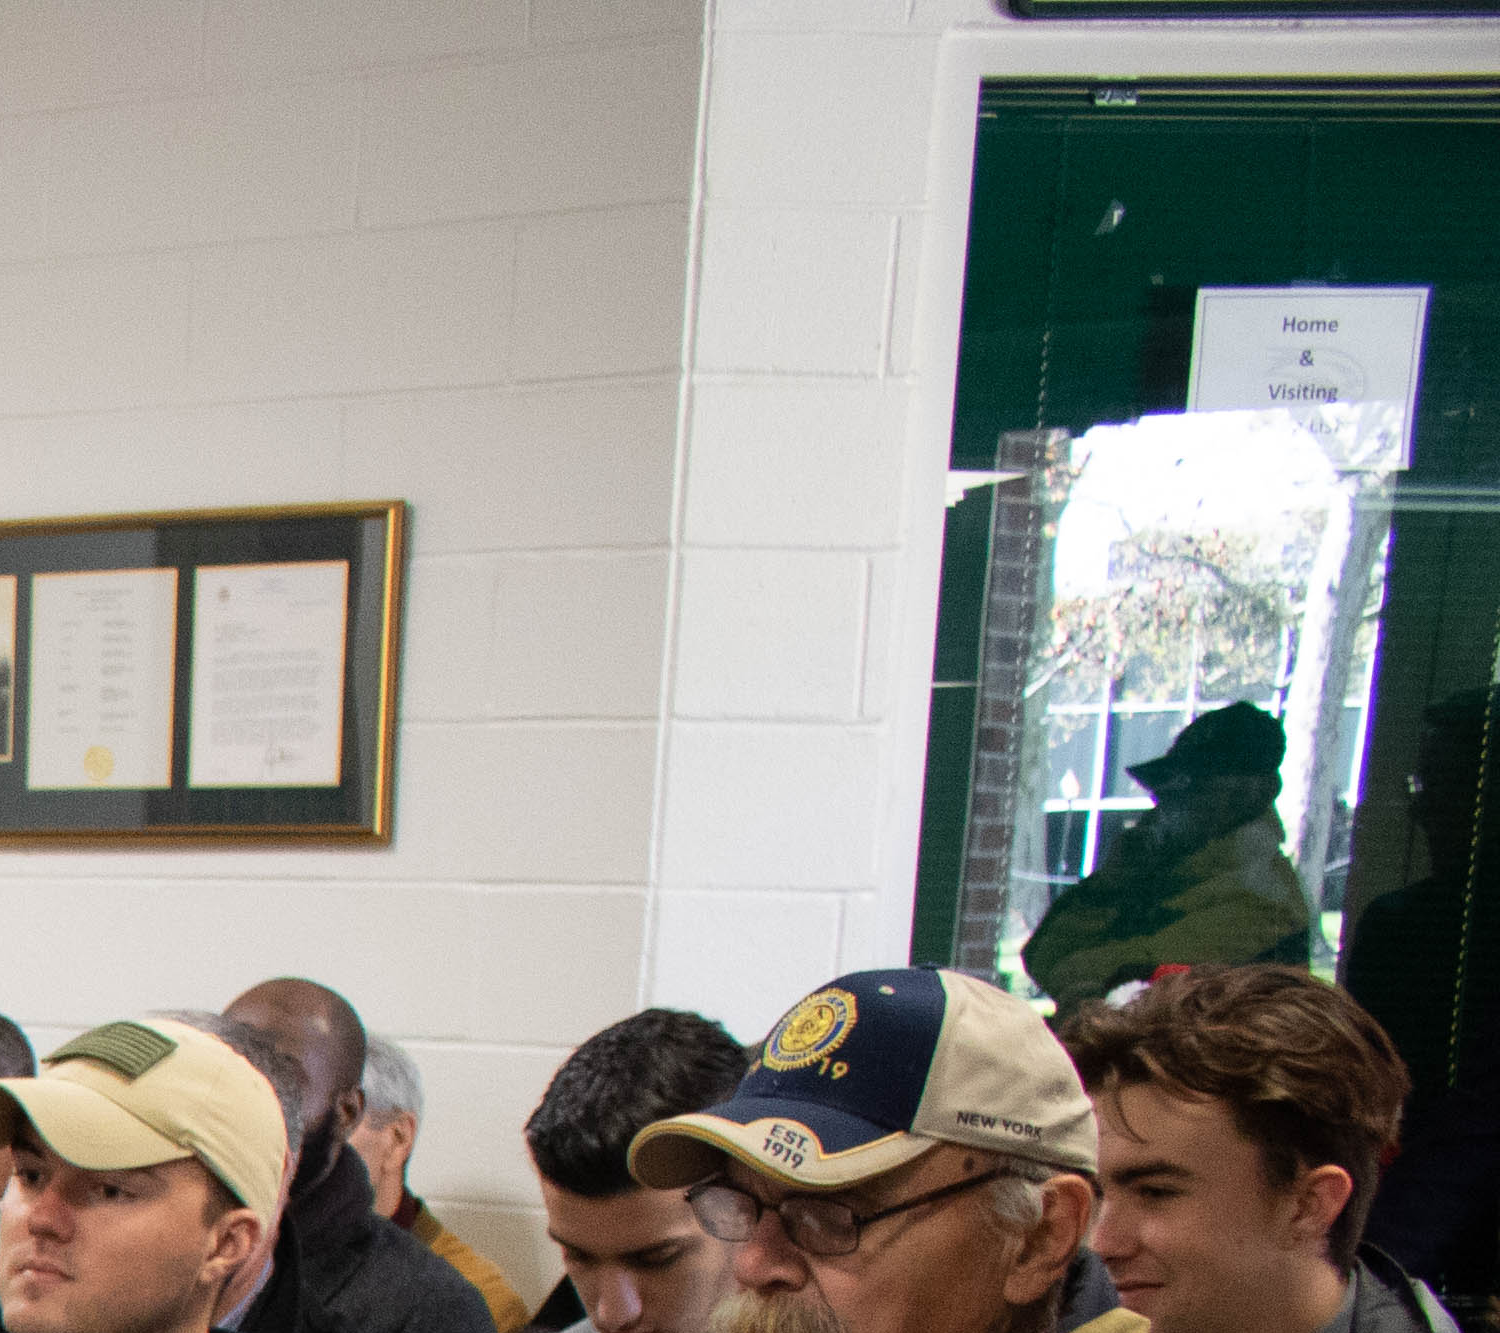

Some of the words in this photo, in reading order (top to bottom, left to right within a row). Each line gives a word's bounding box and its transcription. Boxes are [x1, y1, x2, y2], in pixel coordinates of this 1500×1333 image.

[1282, 316, 1339, 333] Home
[1299, 349, 1314, 366] &
[1268, 383, 1338, 403] Visiting
[818, 1056, 849, 1080] 19
[956, 1111, 996, 1129] NEW
[1002, 1119, 1042, 1138] YORK
[770, 1123, 809, 1152] EST.
[763, 1138, 804, 1169] 1919
